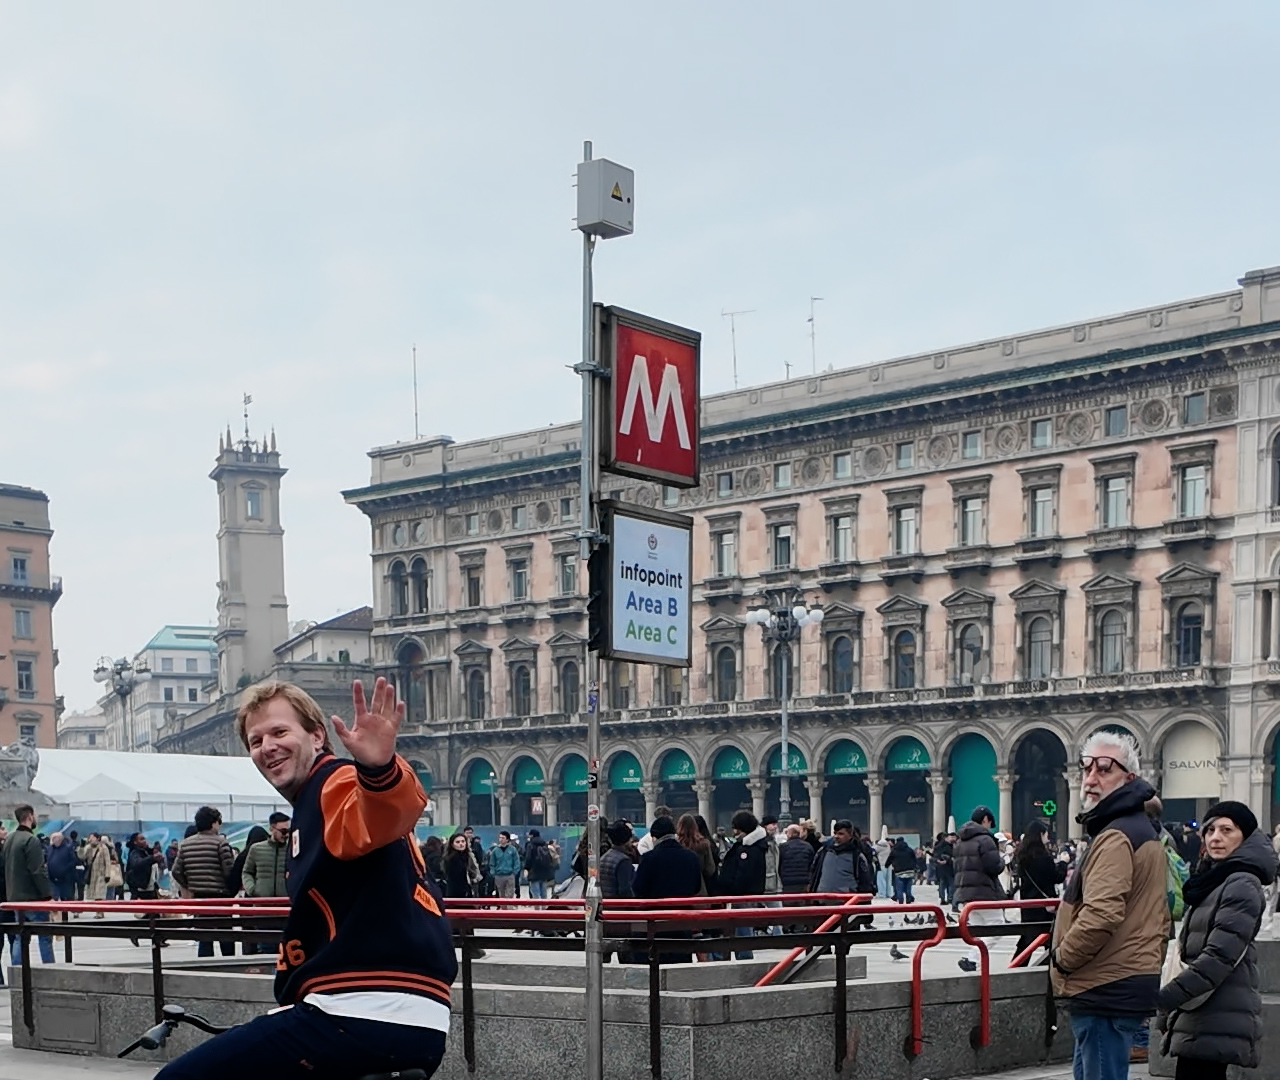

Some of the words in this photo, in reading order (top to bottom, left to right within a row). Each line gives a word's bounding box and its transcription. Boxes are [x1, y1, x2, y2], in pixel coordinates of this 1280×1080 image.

[619, 354, 691, 450] M
[621, 560, 682, 589] infopoint
[626, 590, 662, 615] Area
[668, 597, 678, 617] B
[625, 619, 662, 643] Area
[666, 625, 677, 645] C
[1169, 759, 1217, 770] SALVIN
